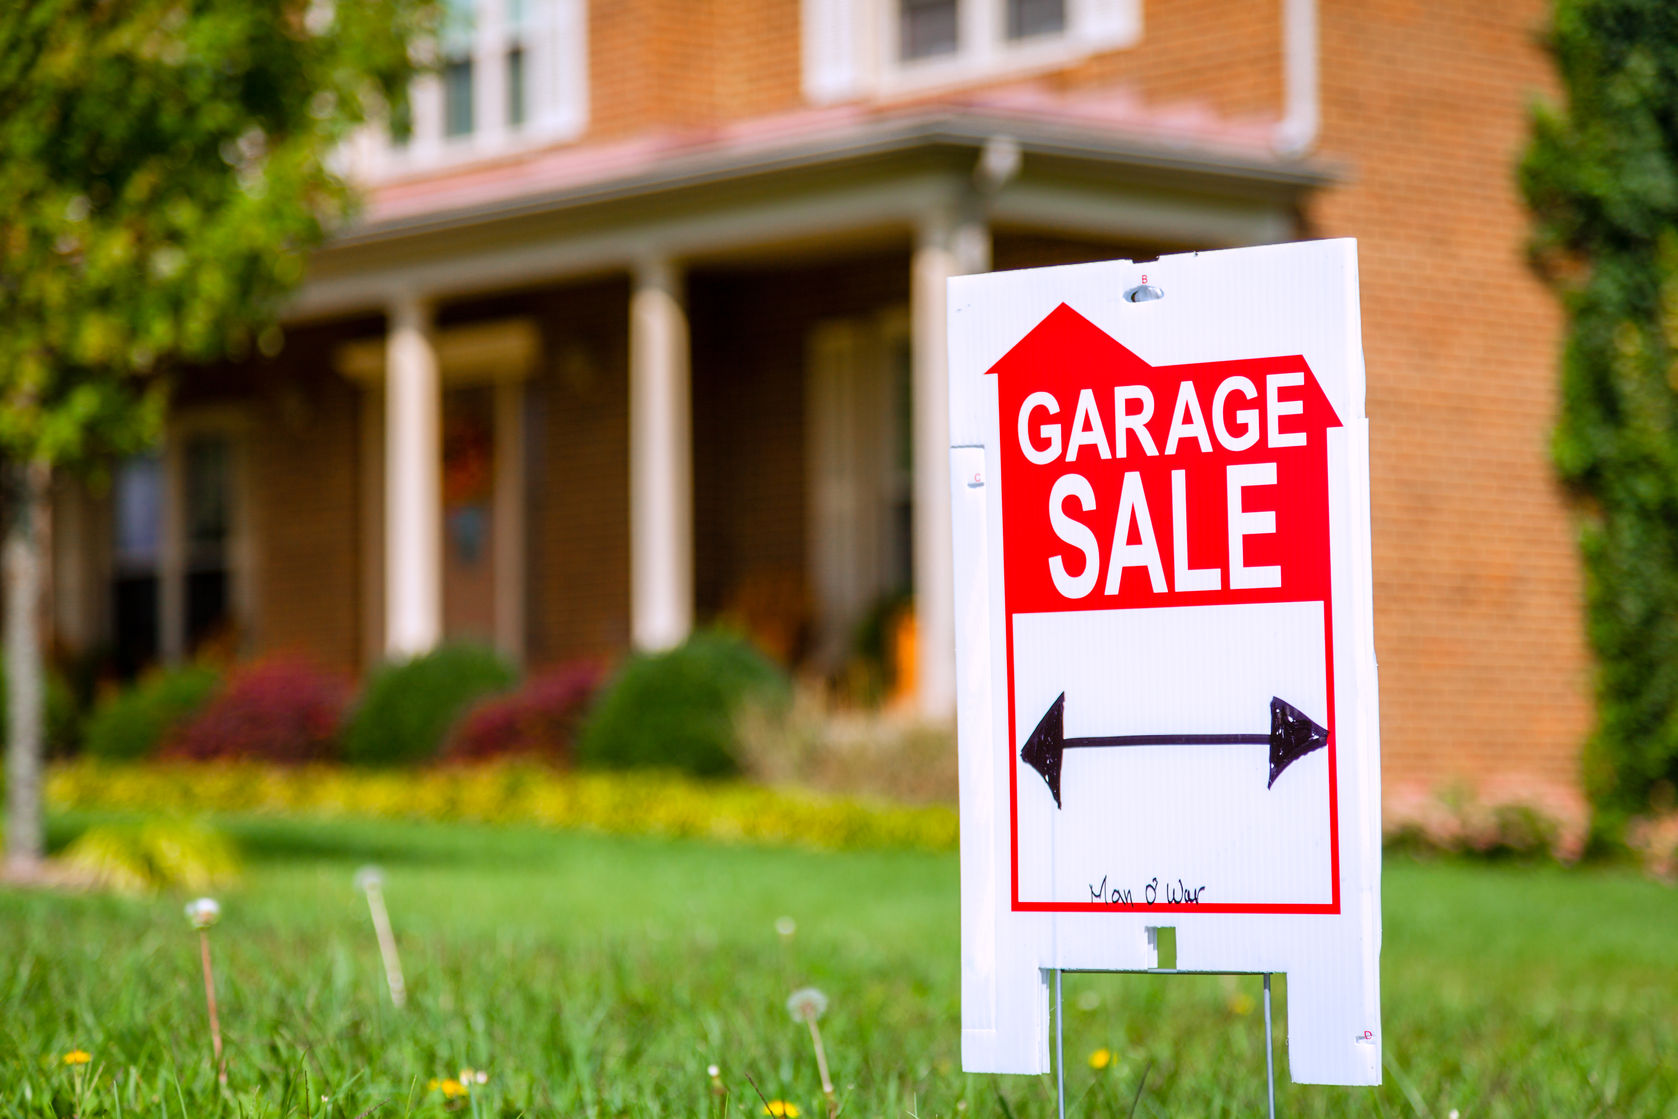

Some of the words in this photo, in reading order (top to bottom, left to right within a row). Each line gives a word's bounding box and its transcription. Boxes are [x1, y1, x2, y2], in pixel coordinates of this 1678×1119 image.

[1141, 274, 1149, 284] B
[1017, 371, 1307, 466] GARAGE
[974, 472, 982, 482] C
[1048, 462, 1282, 600] SALE
[1088, 874, 1134, 908] Man
[1166, 878, 1206, 905] War
